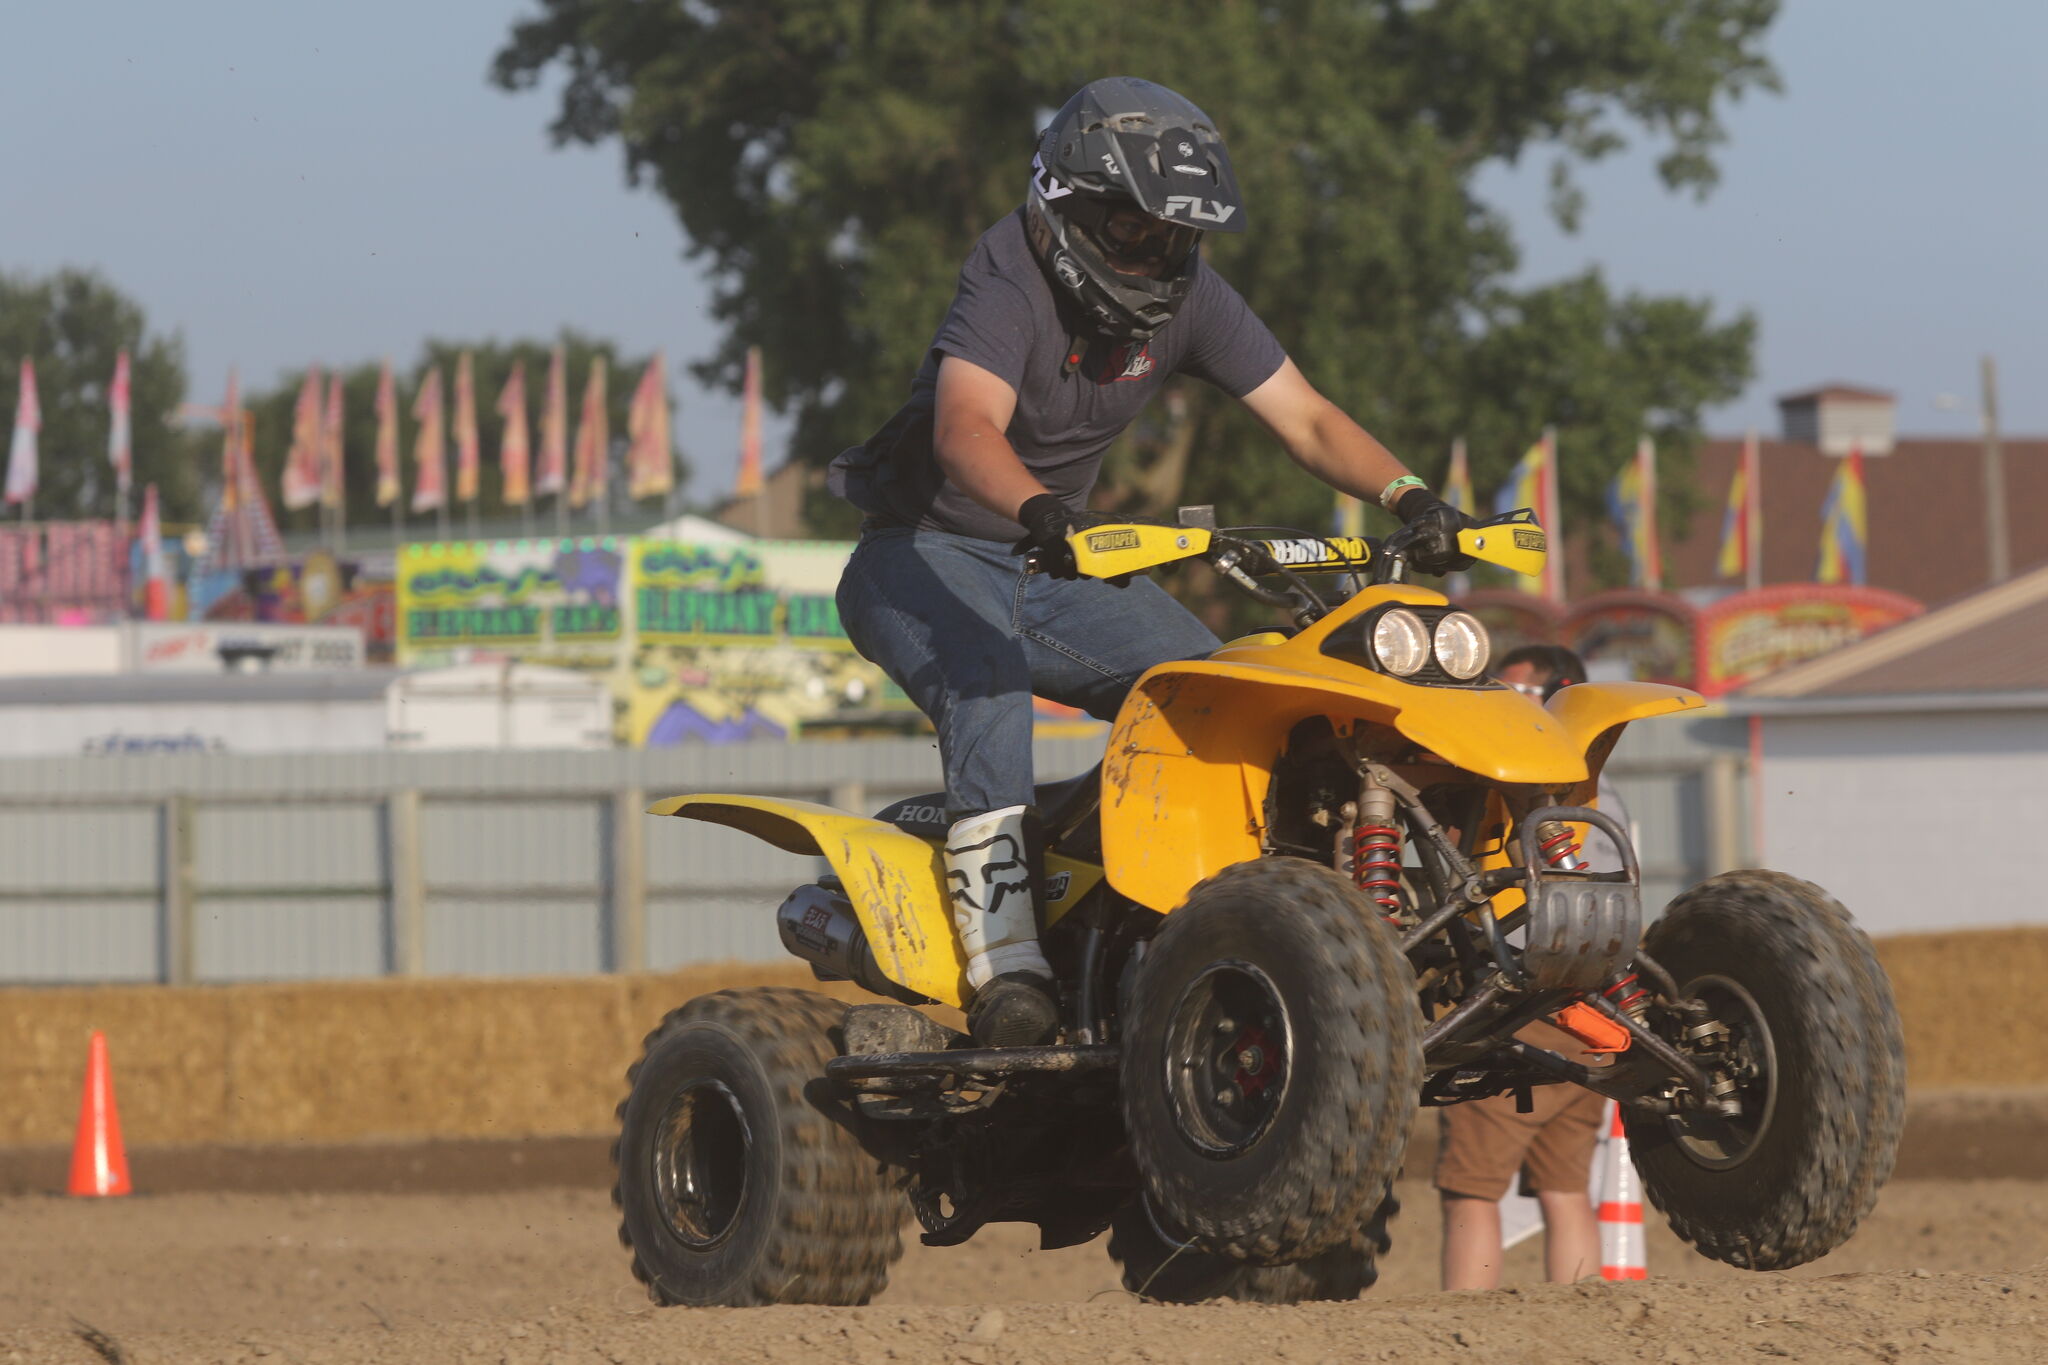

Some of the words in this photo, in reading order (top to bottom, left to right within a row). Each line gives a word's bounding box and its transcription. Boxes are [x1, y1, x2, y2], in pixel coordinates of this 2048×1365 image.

[1101, 153, 1121, 175] FLY
[1165, 195, 1237, 223] FLY
[895, 805, 947, 825] HON
